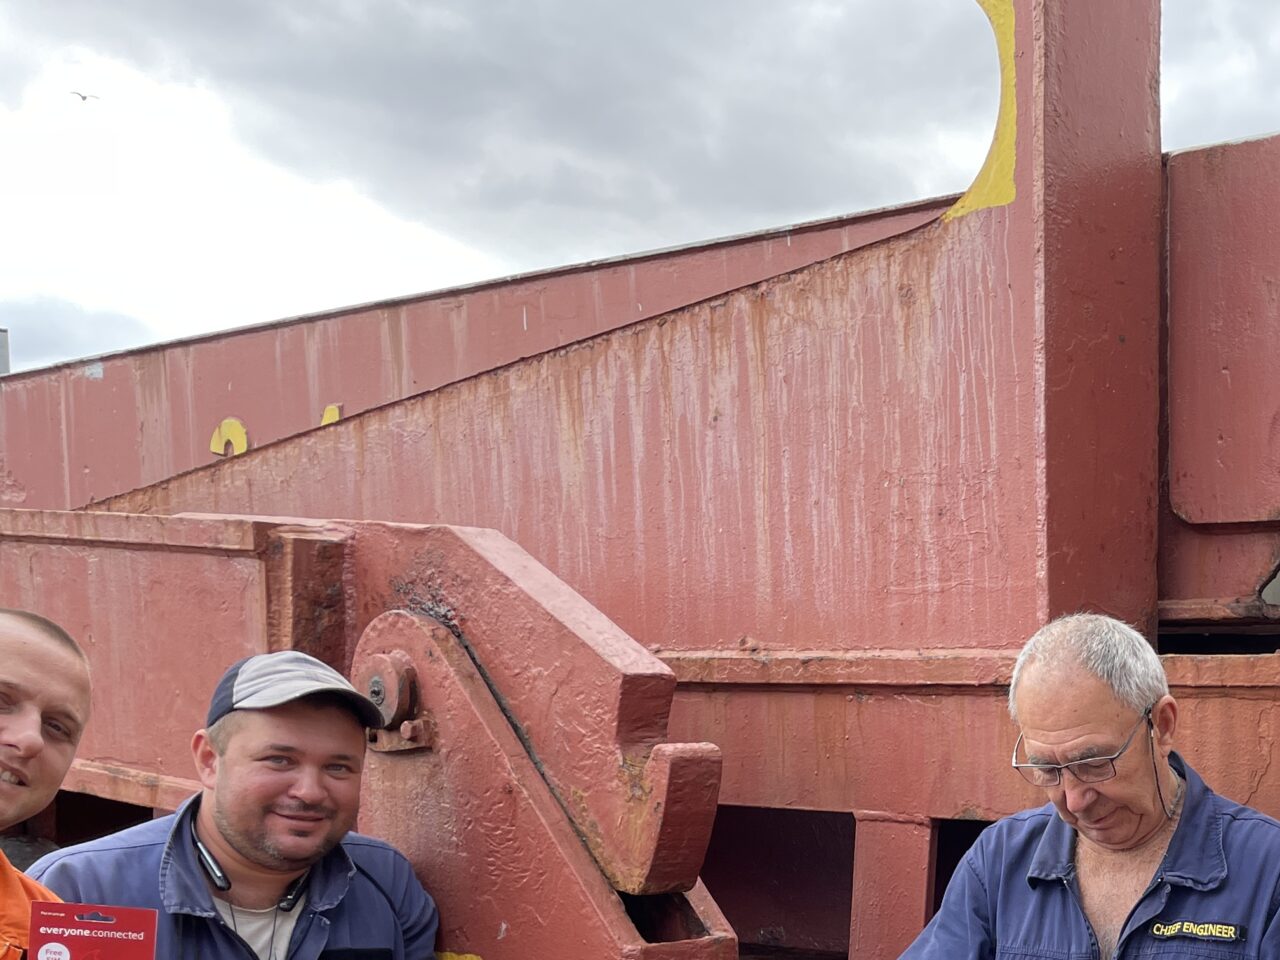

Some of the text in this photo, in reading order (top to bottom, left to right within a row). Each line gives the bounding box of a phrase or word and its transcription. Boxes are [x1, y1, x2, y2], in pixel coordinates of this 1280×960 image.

[39, 926, 144, 941] everyone.connected
[1152, 921, 1236, 938] CHIEF ENGINEER
[45, 949, 63, 957] Free
